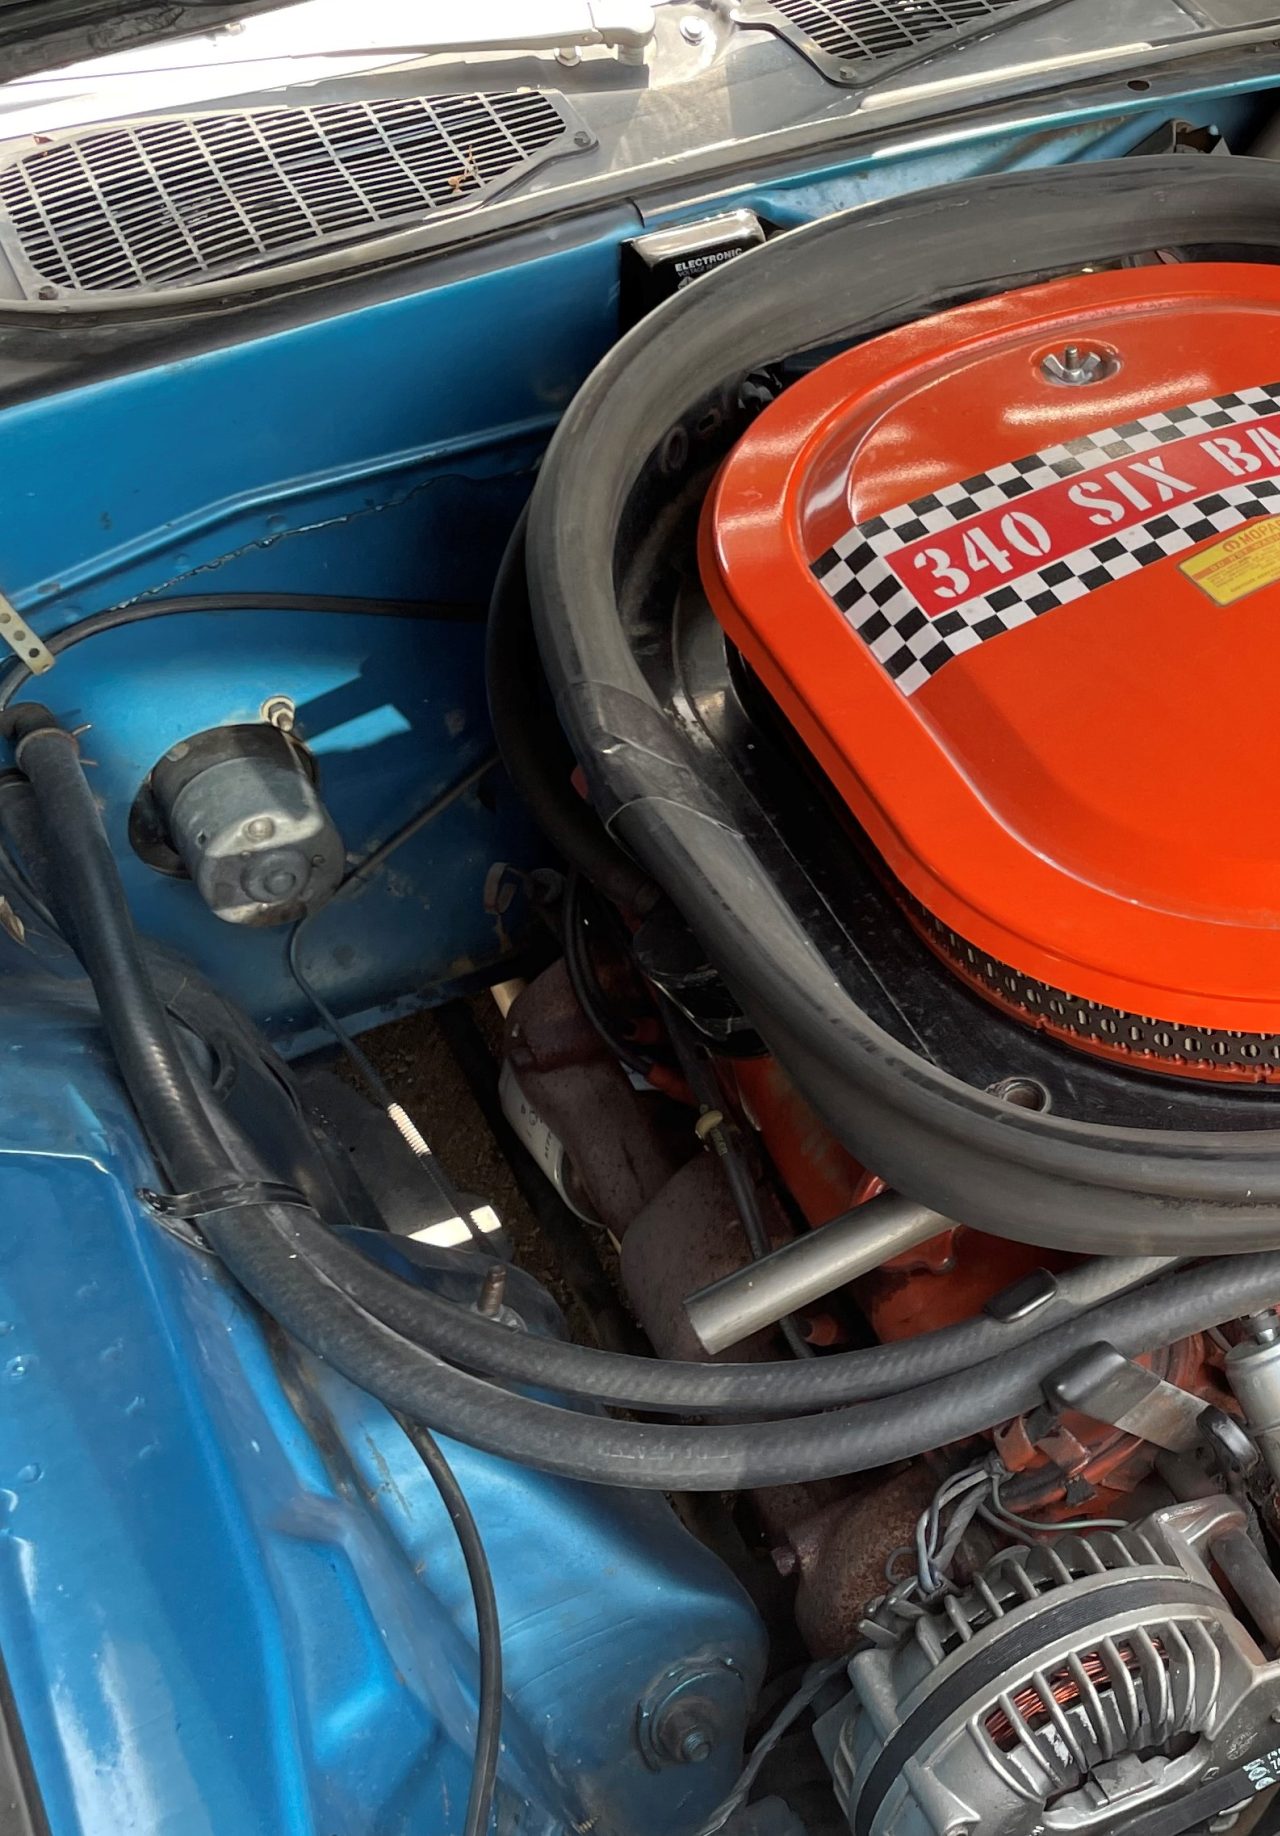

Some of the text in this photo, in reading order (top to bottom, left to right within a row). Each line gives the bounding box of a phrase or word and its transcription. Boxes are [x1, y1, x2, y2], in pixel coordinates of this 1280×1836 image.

[675, 248, 742, 272] ELECTRONIC
[914, 510, 1052, 598] 340
[1068, 455, 1197, 527] SIX
